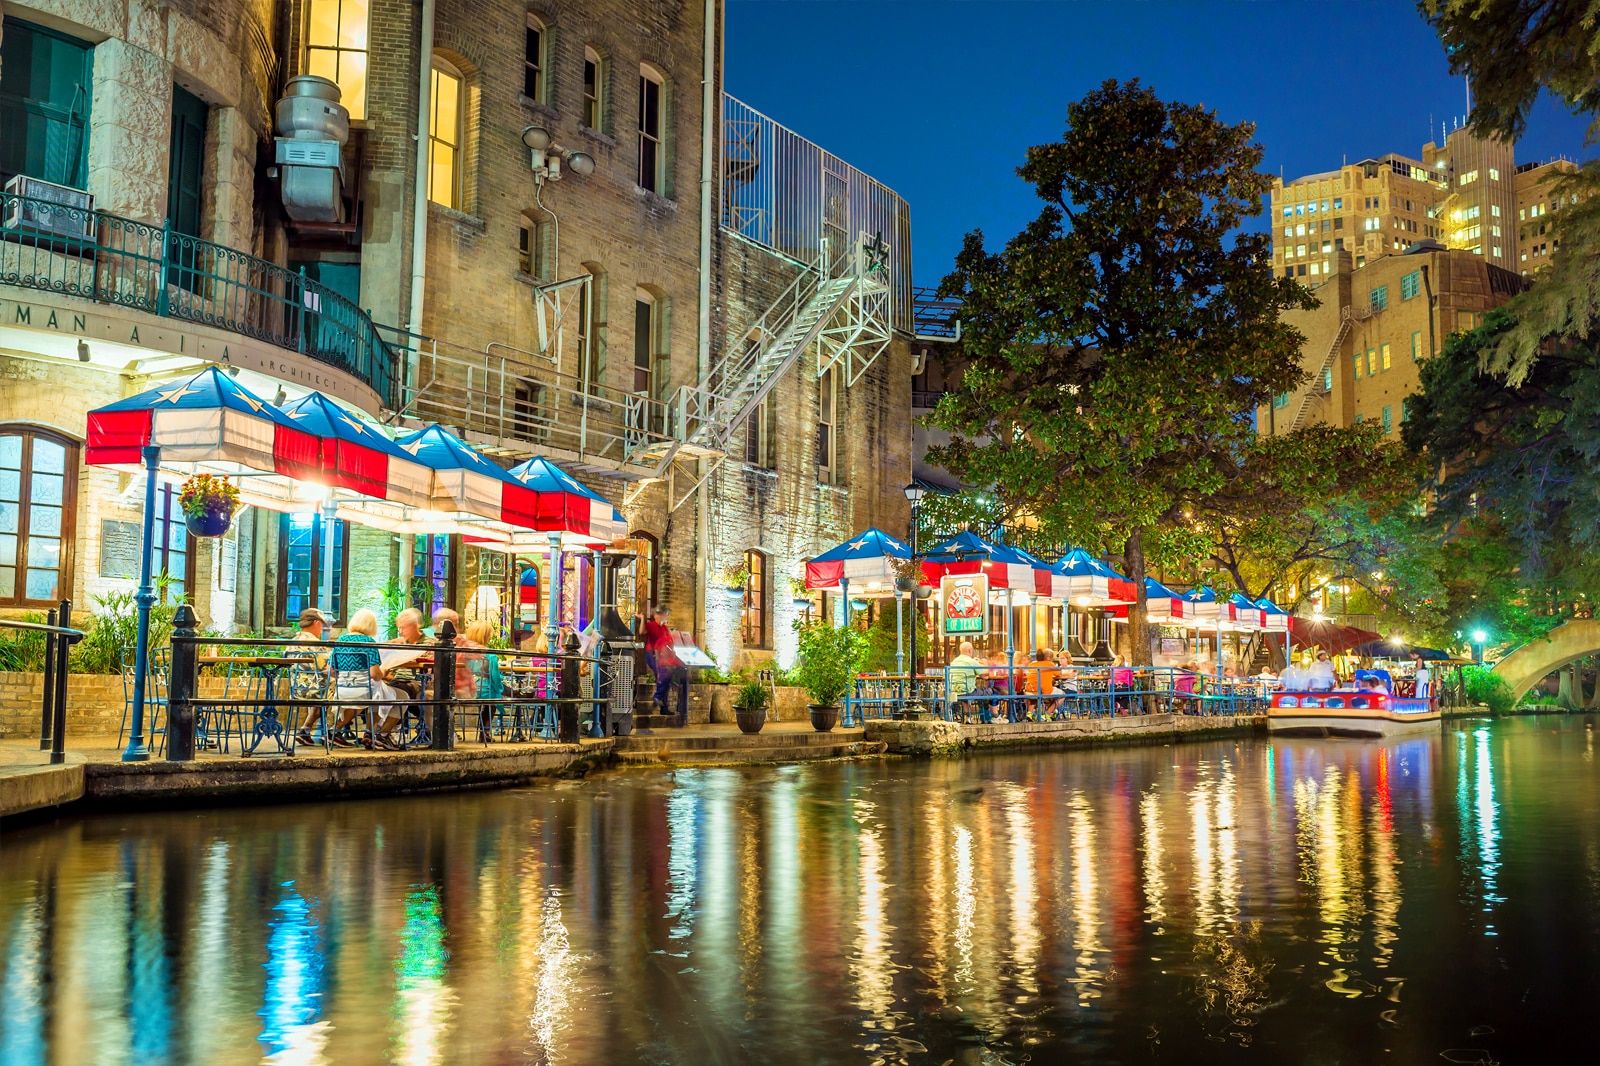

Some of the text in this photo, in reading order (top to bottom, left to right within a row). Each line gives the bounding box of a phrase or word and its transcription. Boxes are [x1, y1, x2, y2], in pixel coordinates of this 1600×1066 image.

[0, 303, 86, 332] MAN
[260, 360, 337, 389] ARCHITECT
[961, 618, 979, 630] TEXAS
